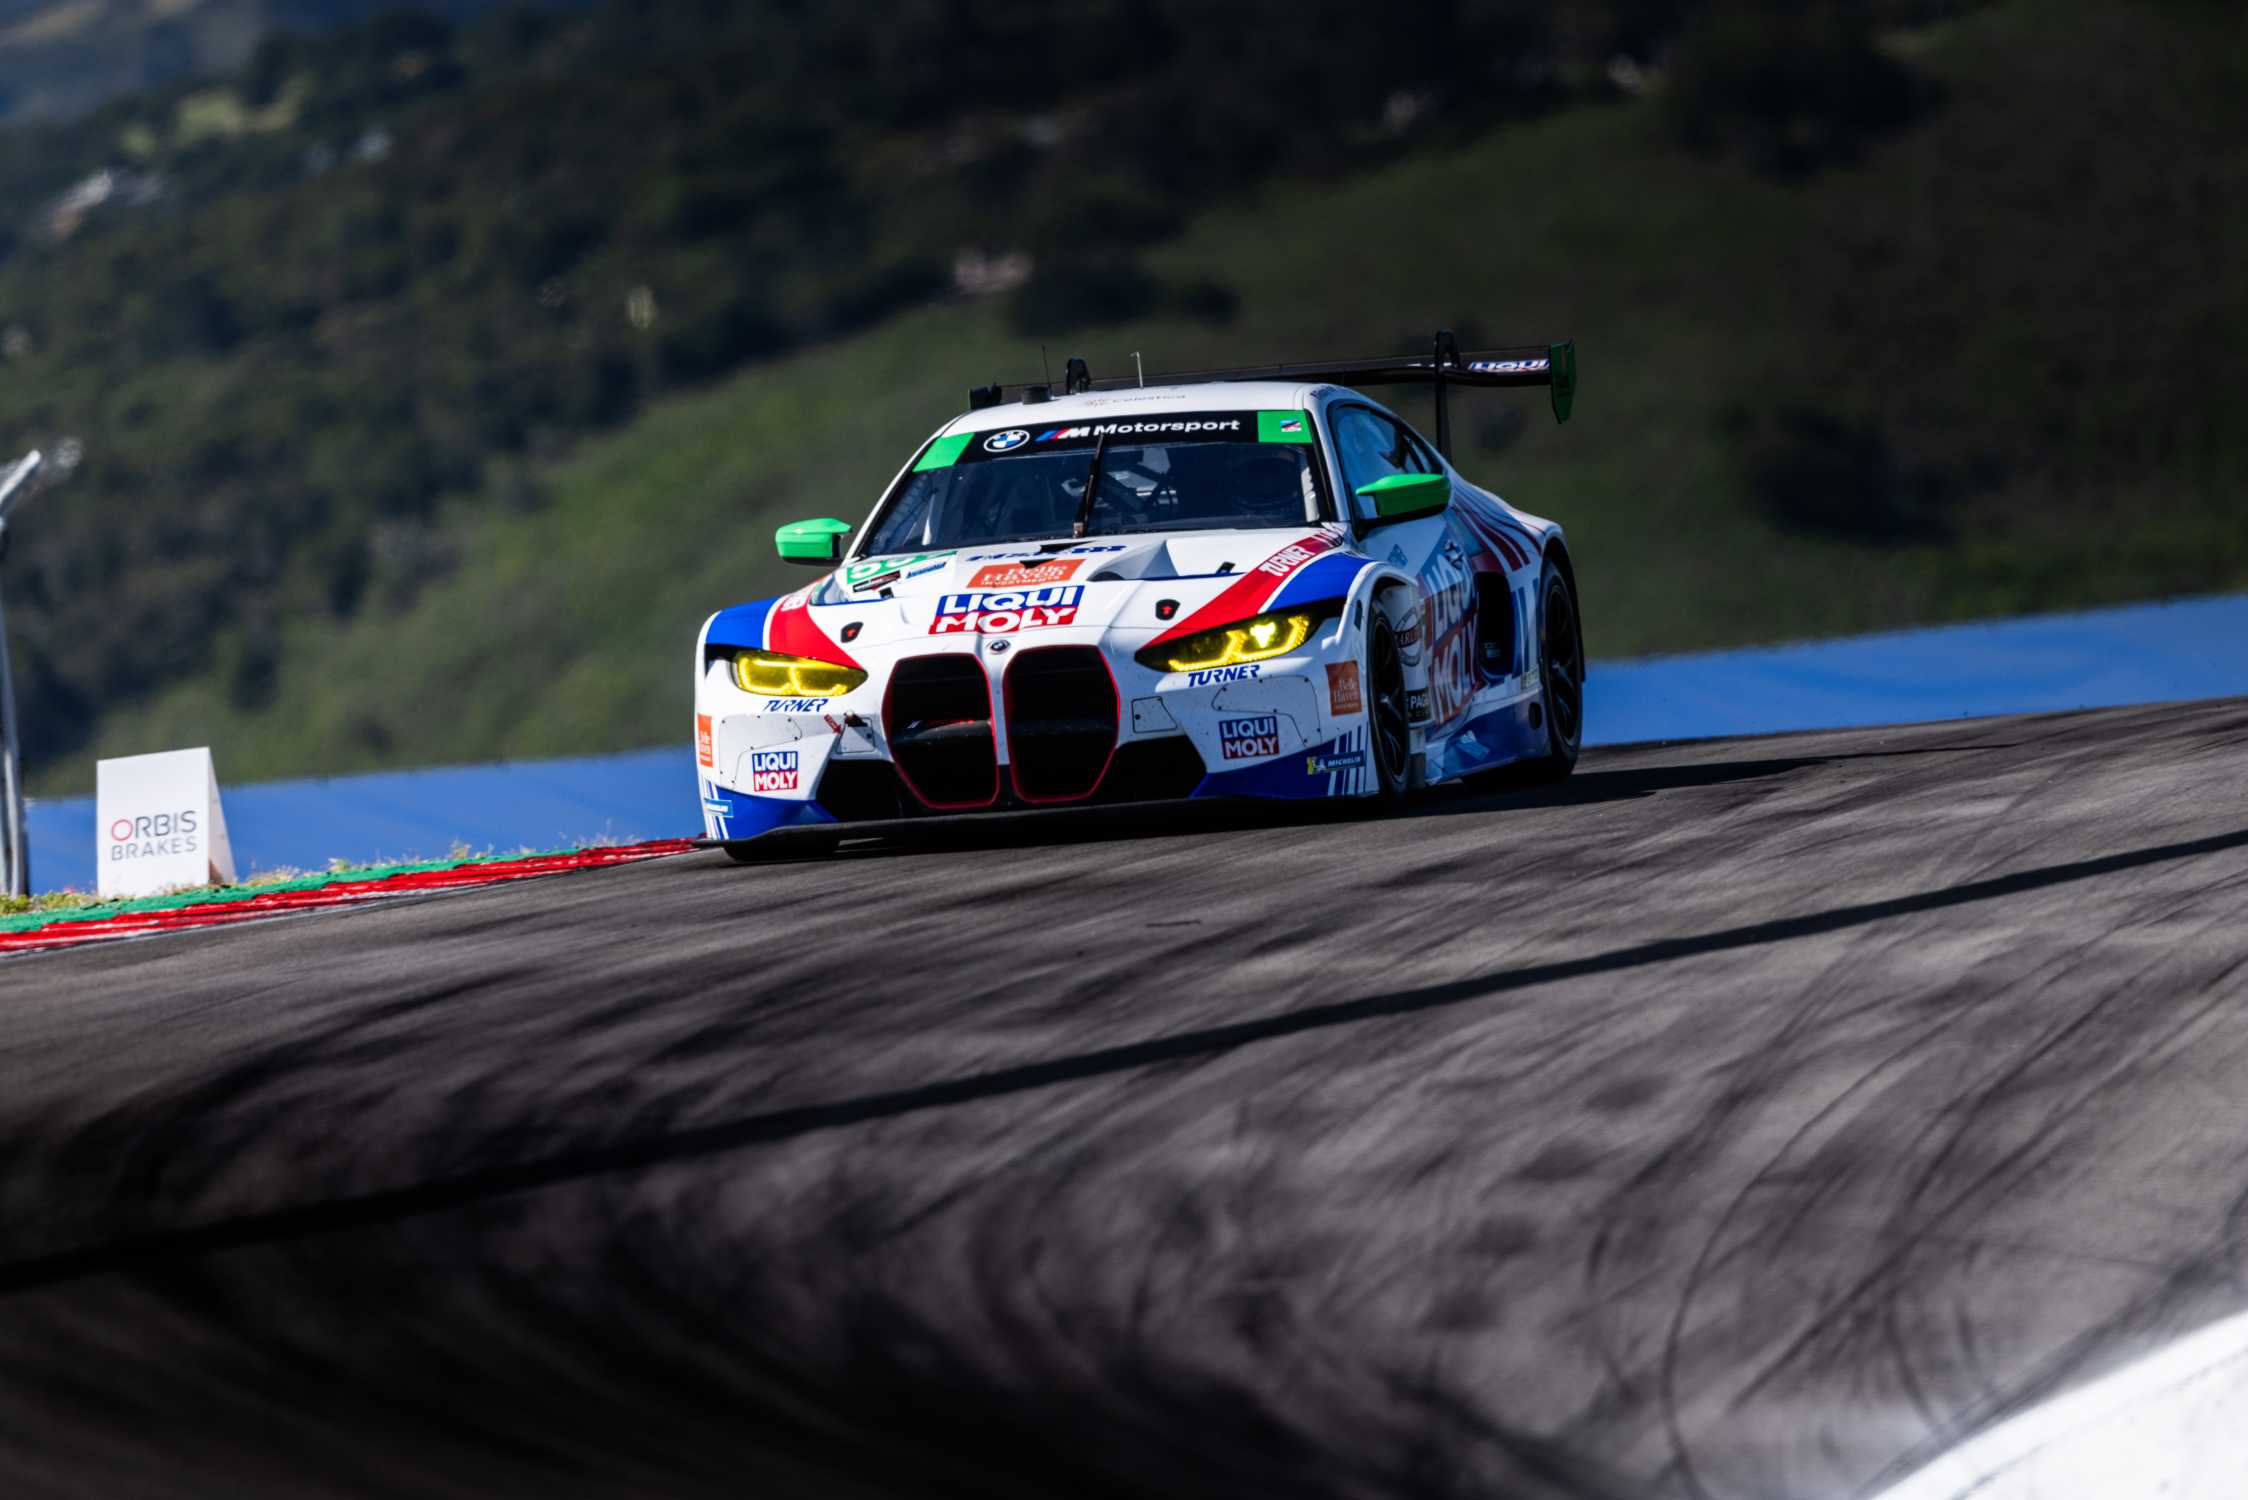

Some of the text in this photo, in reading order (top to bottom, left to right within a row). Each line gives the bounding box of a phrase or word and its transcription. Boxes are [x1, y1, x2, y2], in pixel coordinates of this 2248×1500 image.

[1093, 419, 1241, 437] Motorsport
[1258, 544, 1317, 577] TURNER
[944, 586, 1077, 615] LIQUI
[935, 607, 1076, 634] MOLY
[1187, 664, 1260, 688] TURNER
[763, 698, 829, 712] TURNER
[1220, 717, 1276, 739] LIQUI
[1223, 737, 1279, 758] MOLY
[753, 752, 797, 772] LIQUI
[754, 771, 797, 791] MOLY
[111, 810, 197, 842] ORBIS
[111, 836, 197, 861] BRAKES
